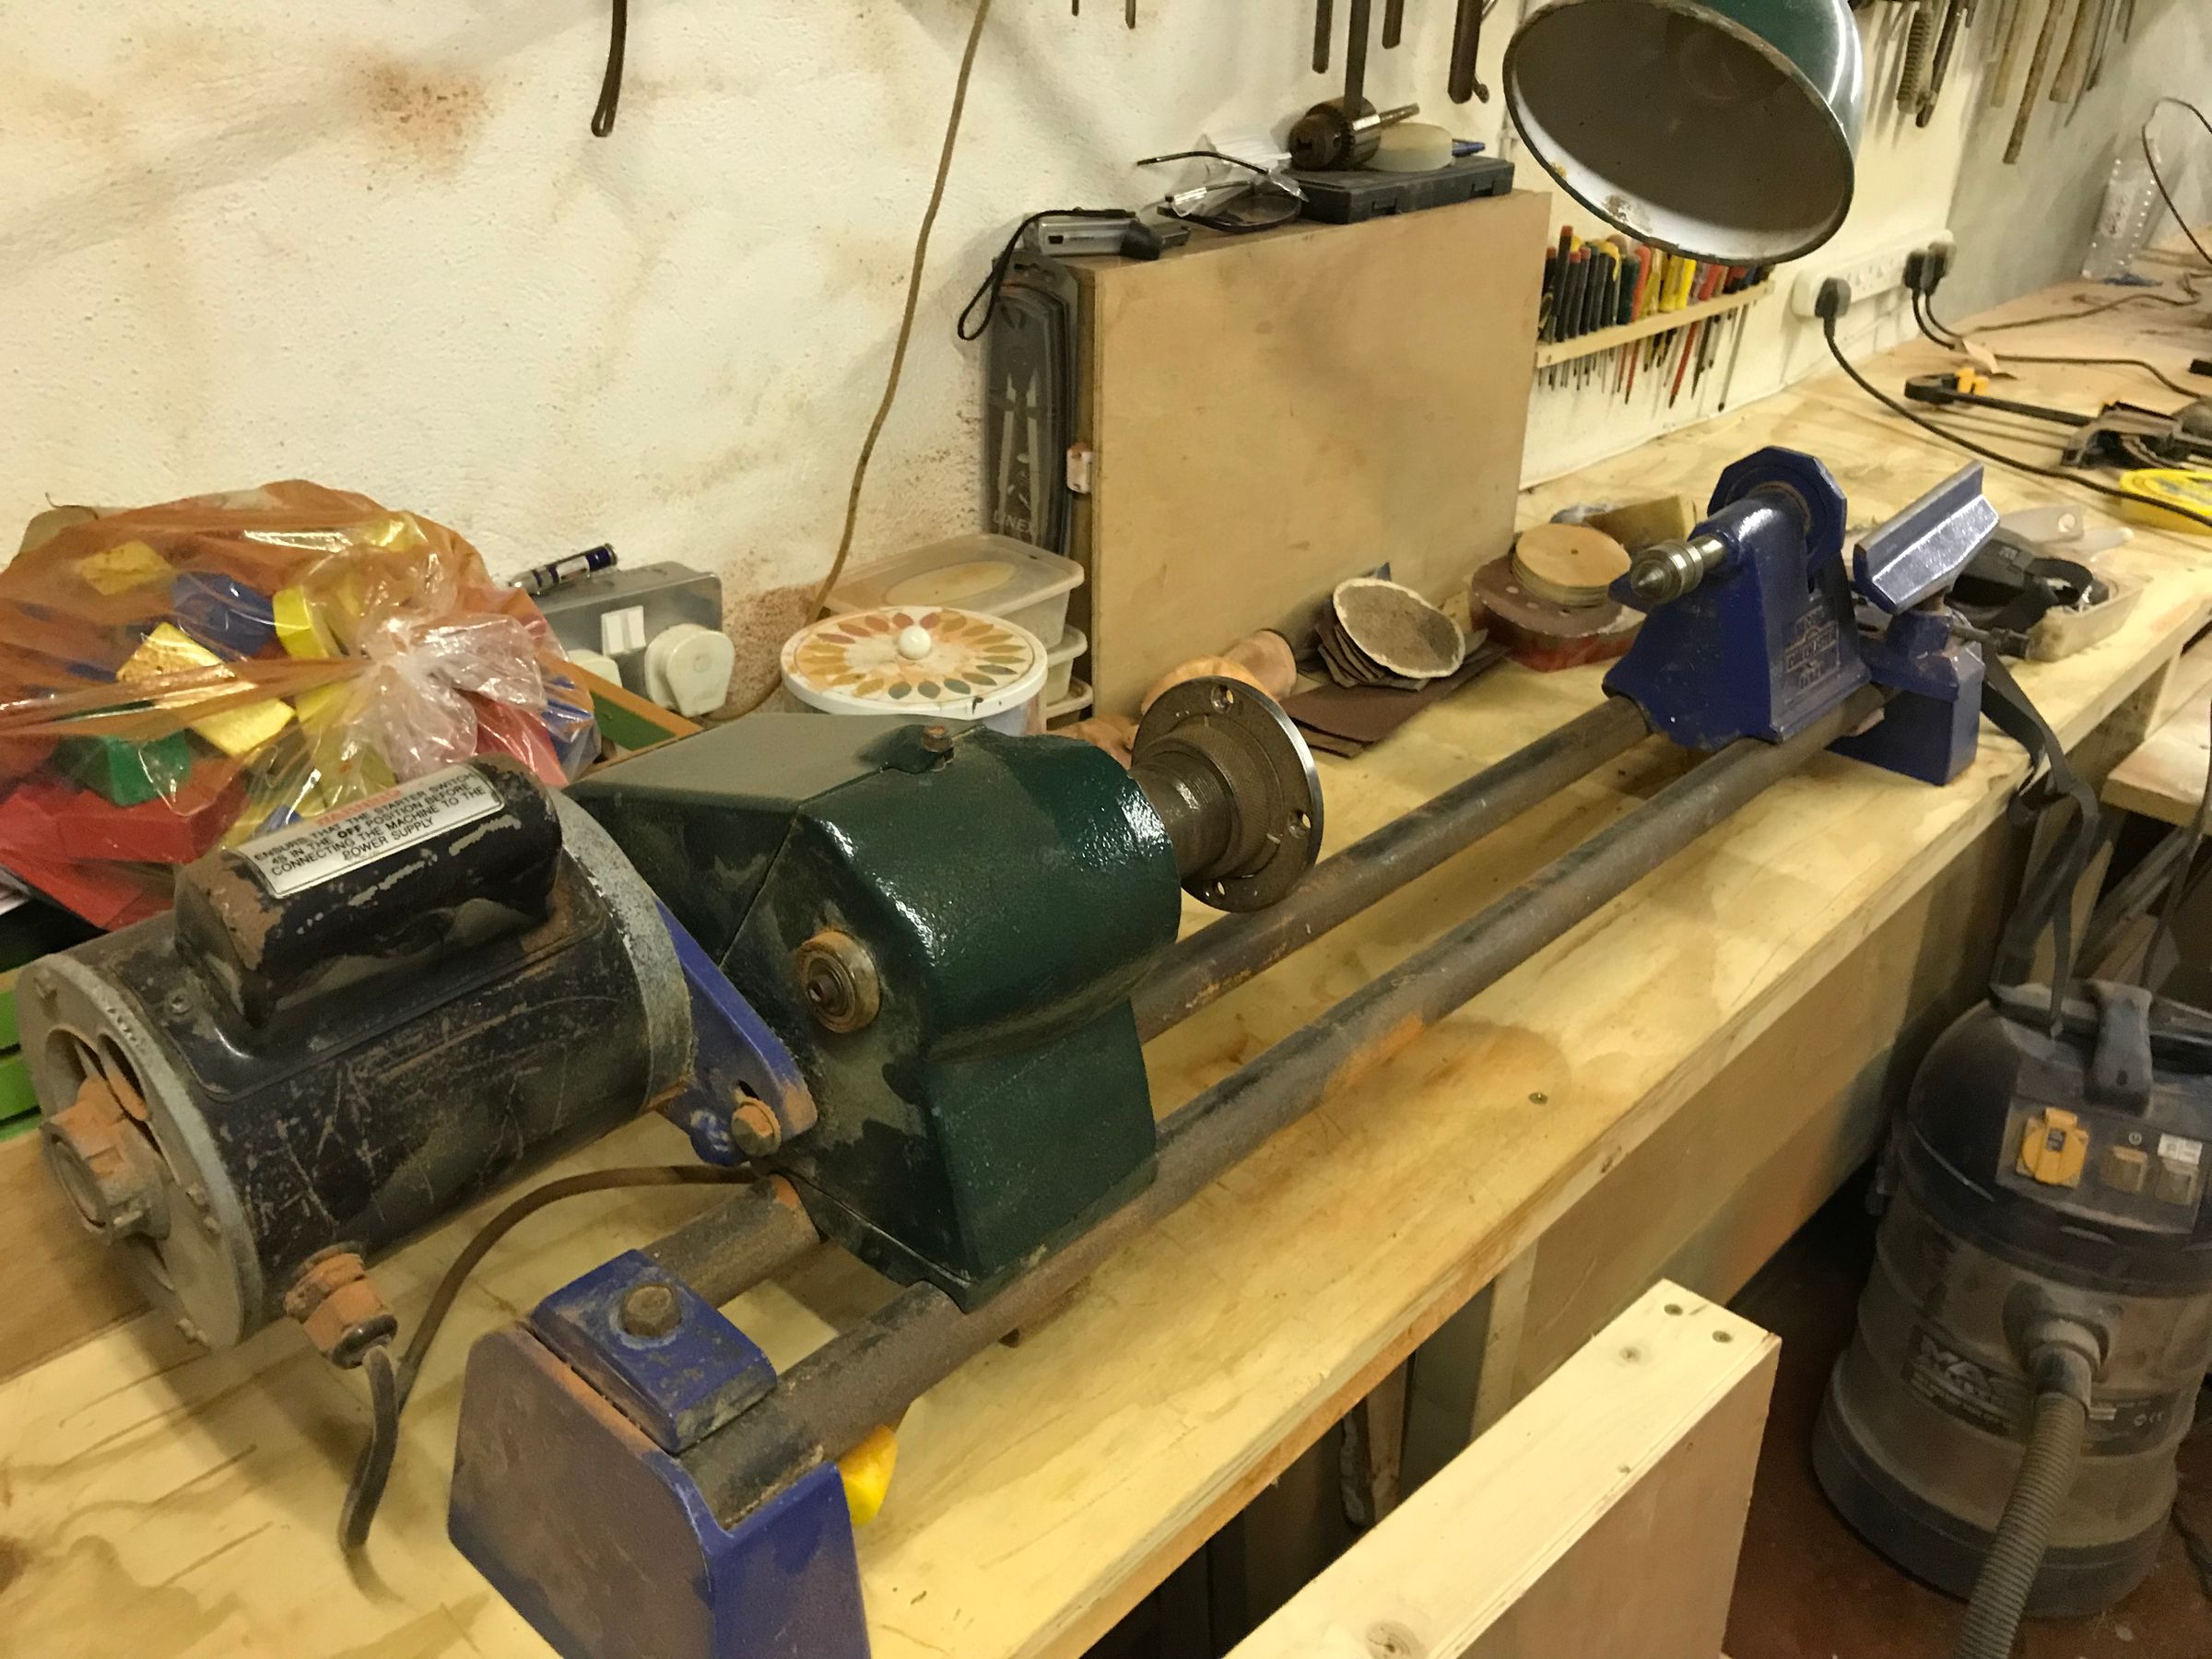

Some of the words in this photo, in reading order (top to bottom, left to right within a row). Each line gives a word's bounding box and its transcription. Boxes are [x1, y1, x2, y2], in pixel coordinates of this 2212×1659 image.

[254, 837, 309, 861] ENSURE
[311, 823, 341, 840] THAT
[347, 811, 368, 825] THE
[373, 790, 428, 813] STARTER
[429, 772, 474, 792] SWITCH
[271, 838, 356, 876] CONNECTING
[358, 826, 384, 842] THE
[384, 804, 440, 831] MACHINE
[441, 796, 459, 808] TO
[461, 785, 487, 801] THE
[289, 846, 305, 858] IN
[308, 836, 333, 851] THE
[337, 824, 362, 838] OFF
[365, 802, 423, 828] POSITION
[424, 782, 470, 806] BEFORE
[342, 834, 389, 861] POWER
[391, 817, 434, 841] SUPPLY
